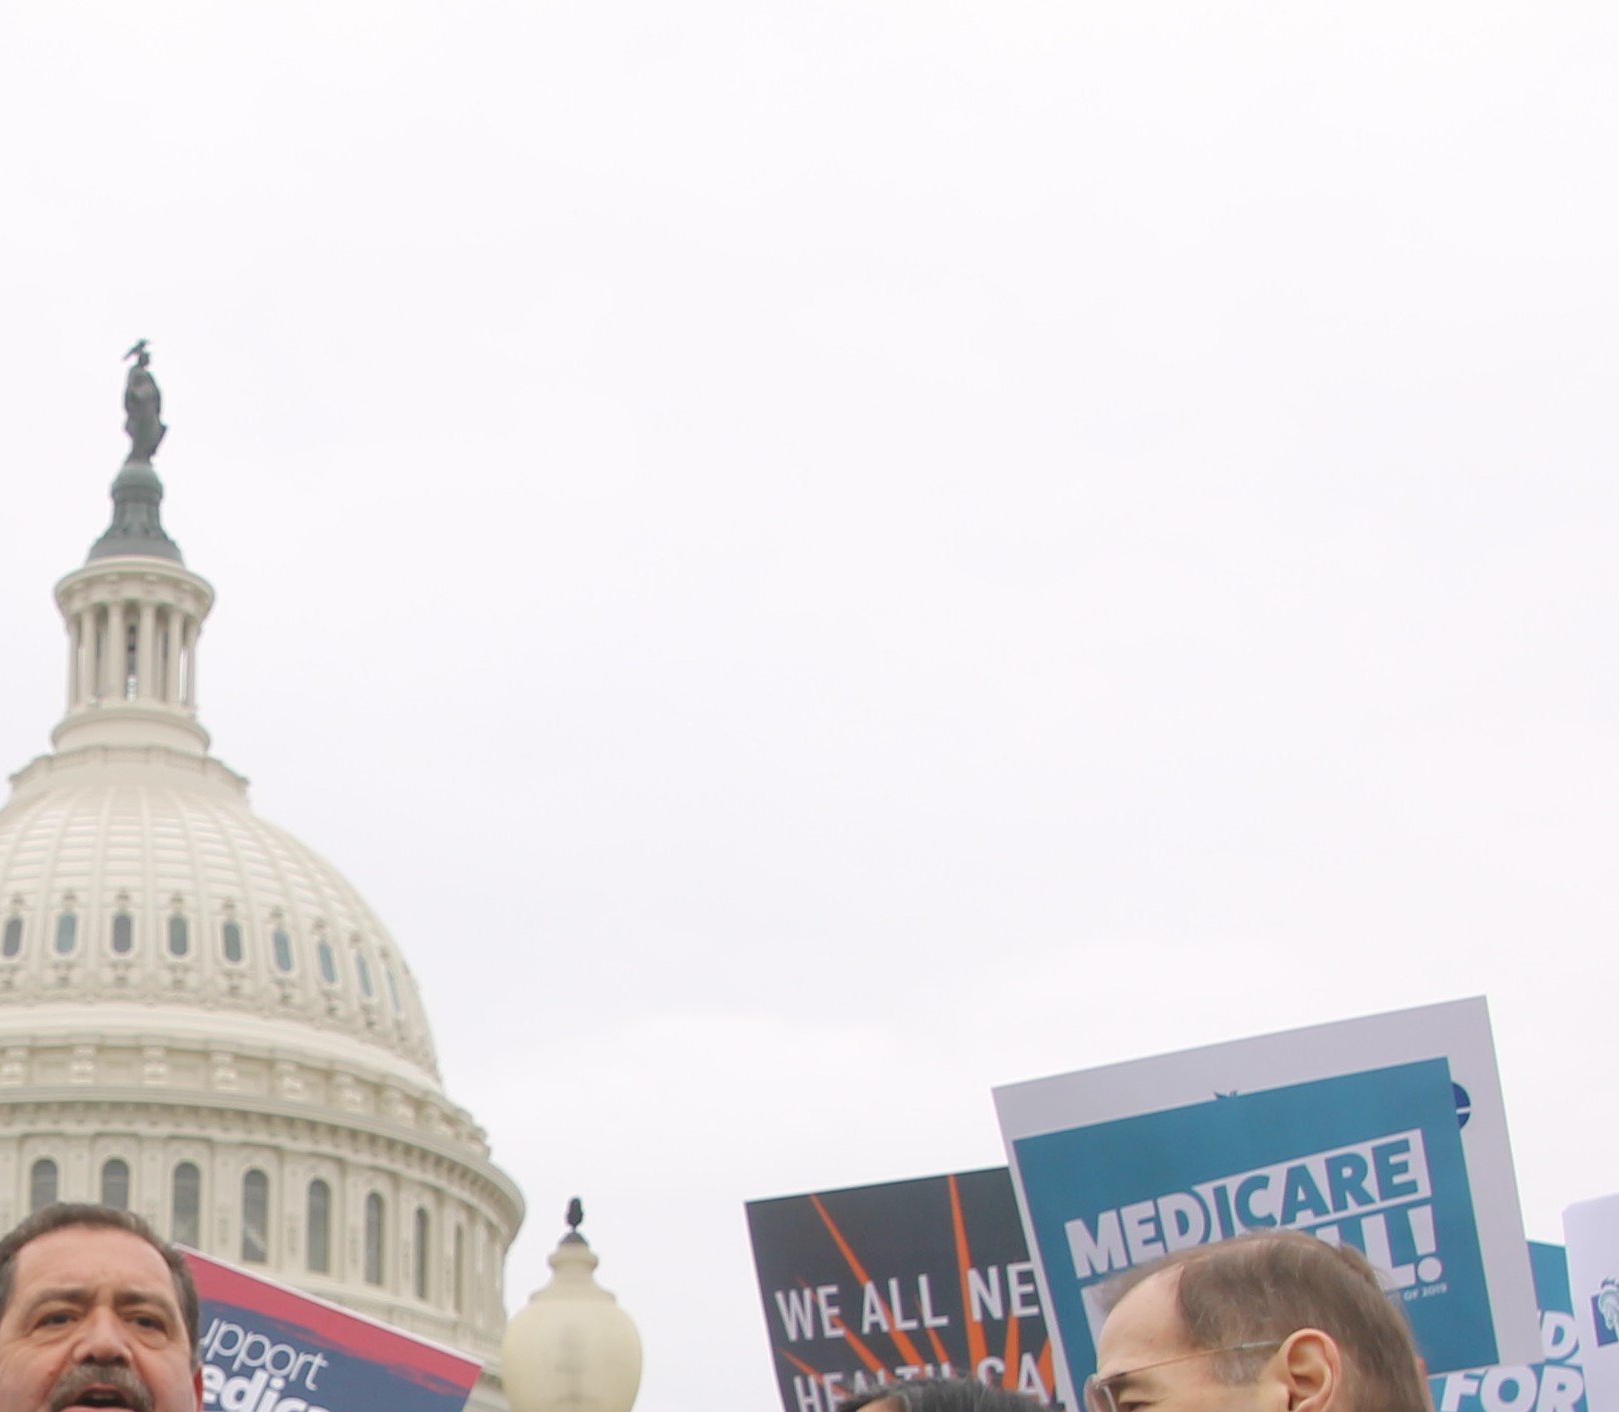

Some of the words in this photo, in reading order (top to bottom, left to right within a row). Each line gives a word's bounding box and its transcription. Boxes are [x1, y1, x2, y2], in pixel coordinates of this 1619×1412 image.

[1064, 1138, 1419, 1279] MEDICARE
[775, 1285, 846, 1342] WE
[861, 1274, 949, 1334] ALL
